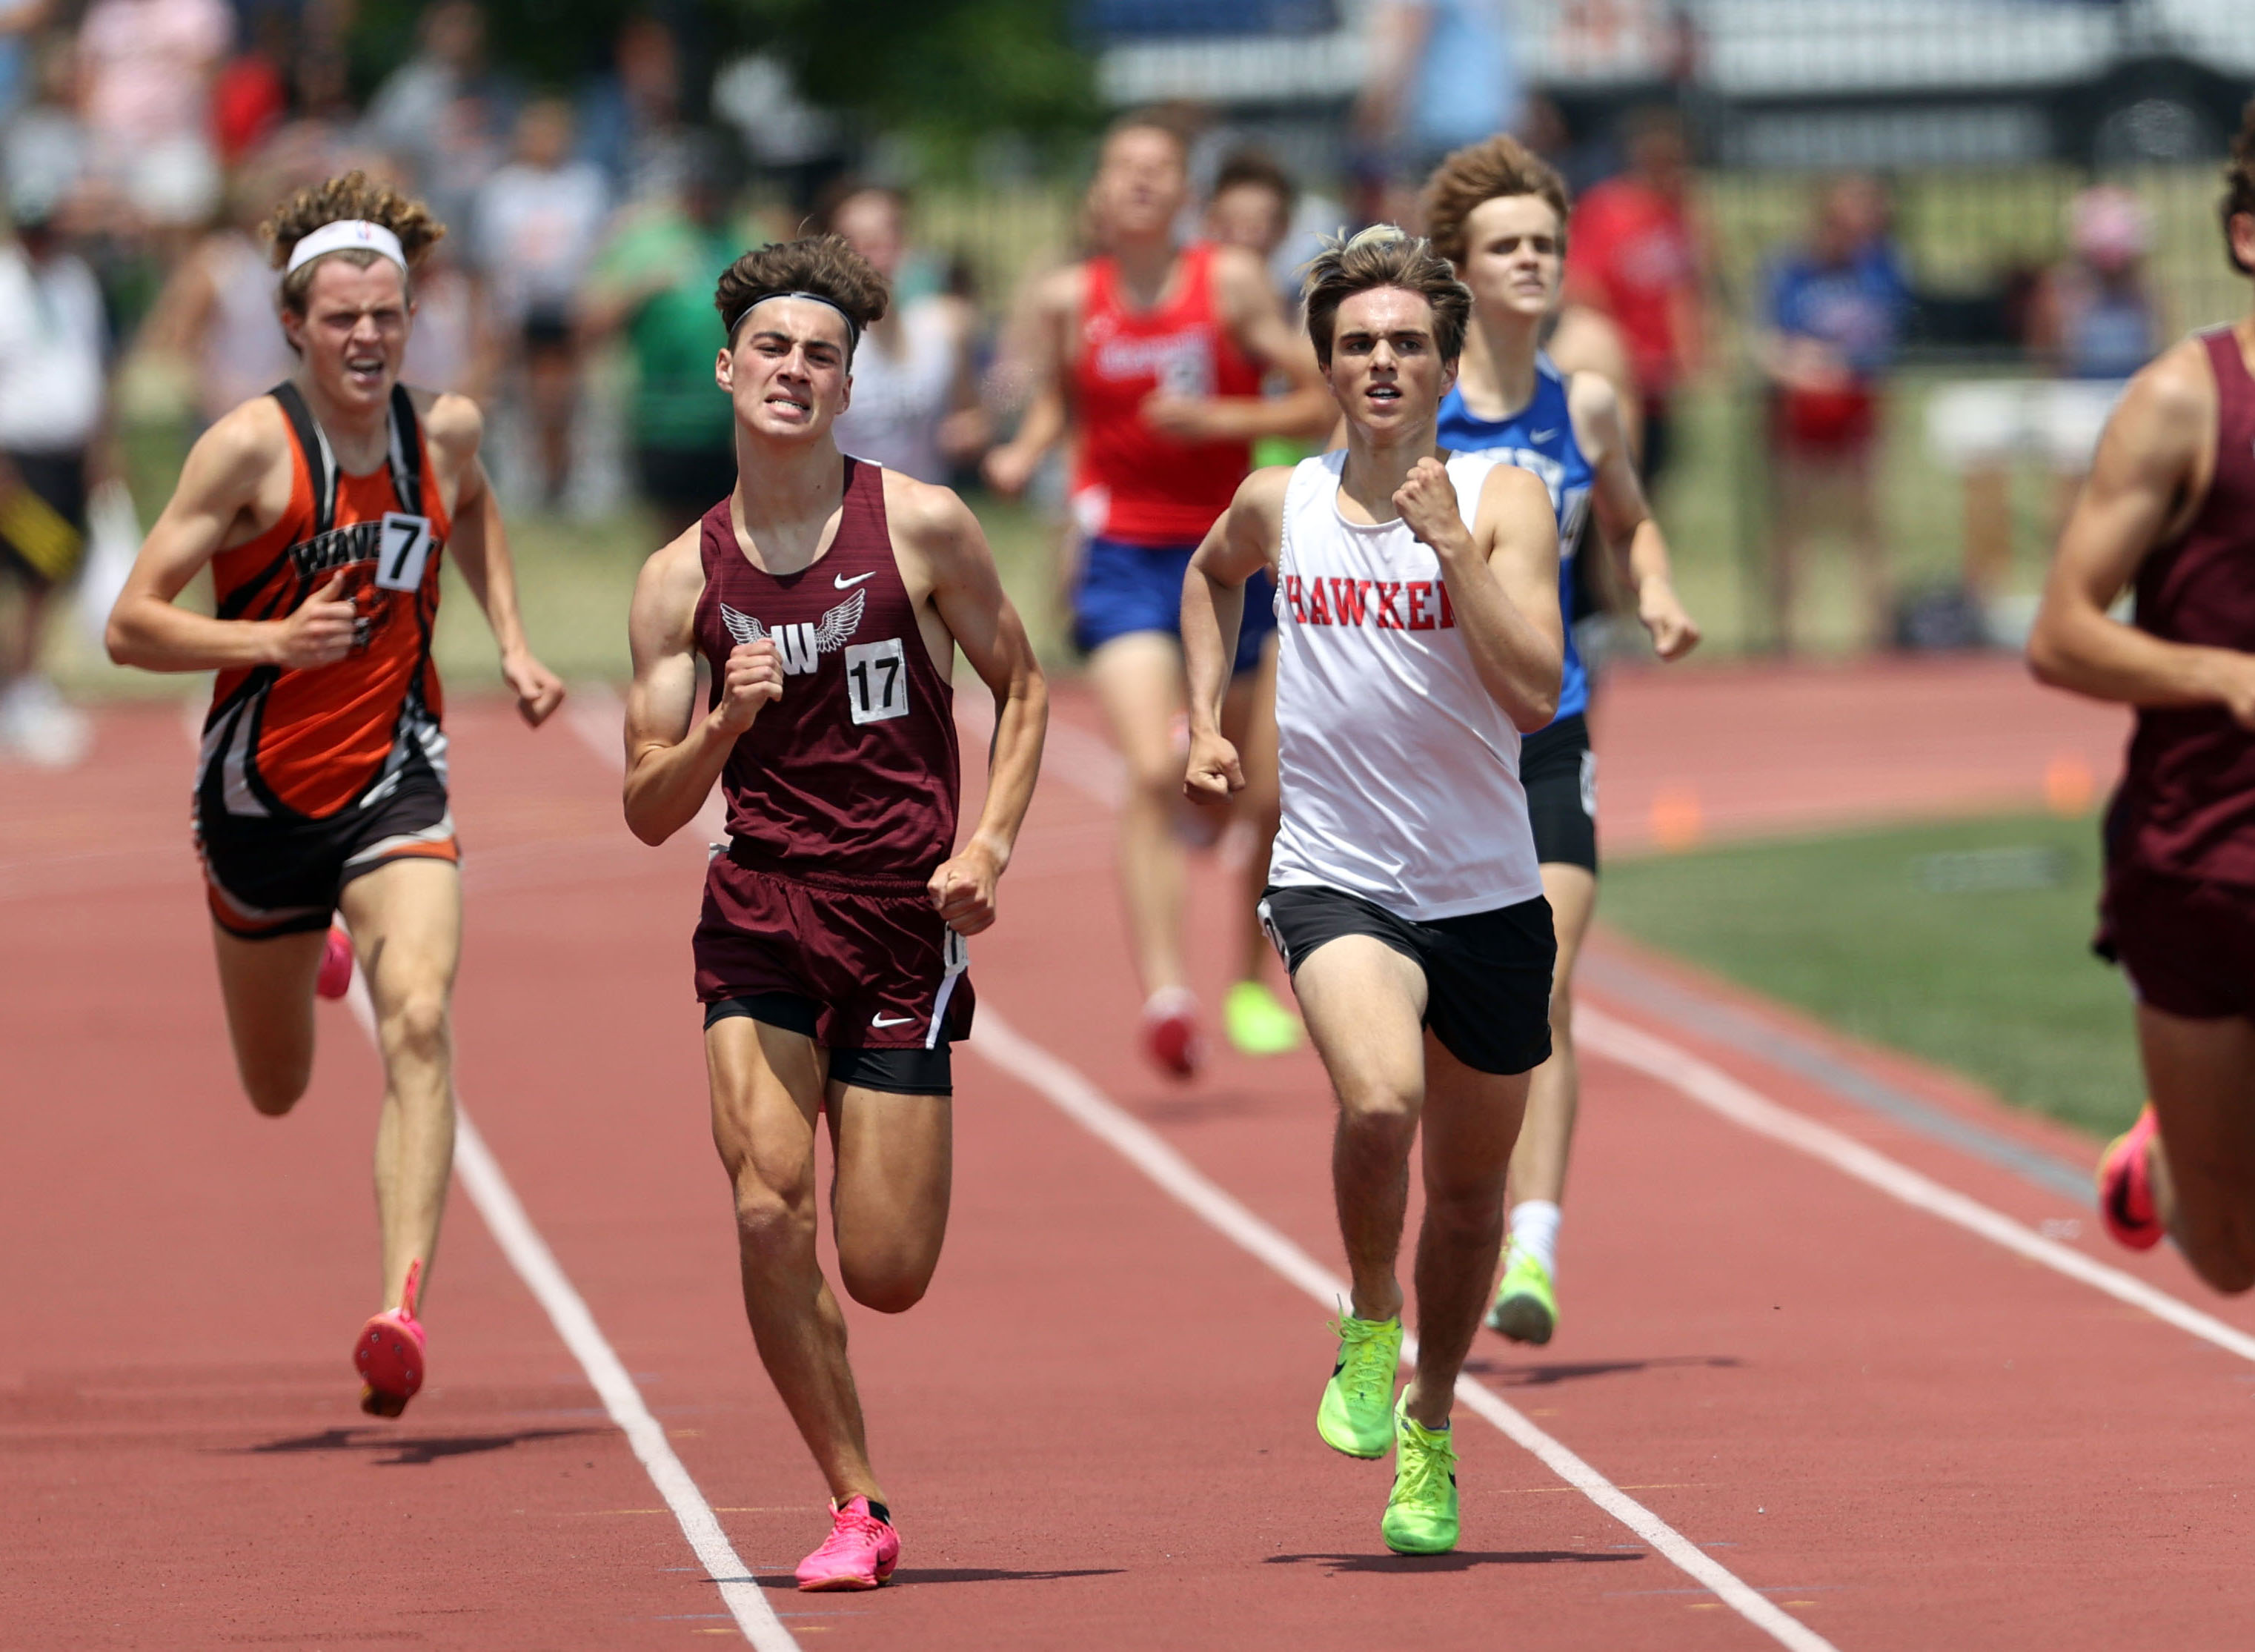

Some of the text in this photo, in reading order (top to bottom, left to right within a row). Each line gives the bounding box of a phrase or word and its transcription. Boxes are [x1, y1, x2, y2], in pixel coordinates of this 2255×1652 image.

[288, 520, 439, 581] WAVE
[389, 518, 421, 580] 7
[771, 623, 818, 675] W
[850, 657, 900, 711] 17
